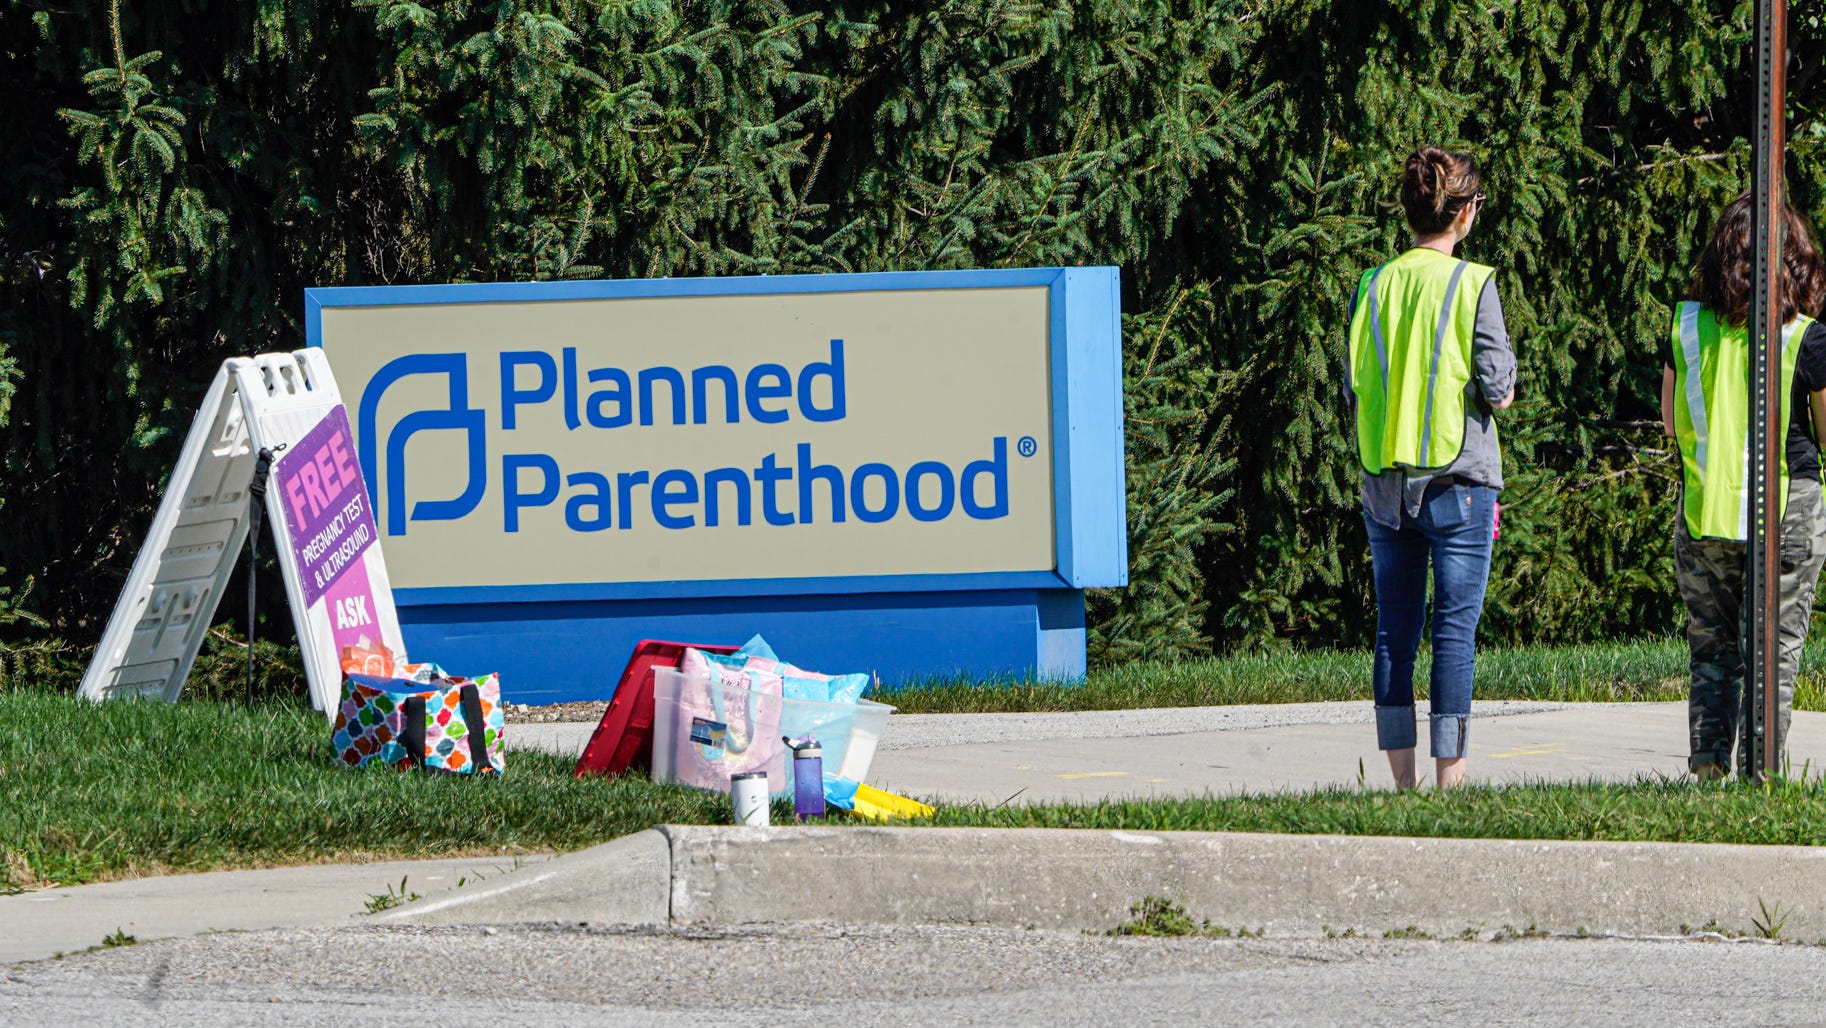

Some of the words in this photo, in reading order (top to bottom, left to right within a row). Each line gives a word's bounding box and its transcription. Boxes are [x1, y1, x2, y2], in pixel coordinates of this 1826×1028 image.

[500, 339, 846, 431] Planned
[286, 429, 357, 532] FREE
[302, 511, 346, 567] PREGNANCY
[344, 493, 364, 525] TEST
[315, 569, 325, 589] &
[323, 523, 369, 580] ULTRASOUND
[336, 595, 371, 630] ASK
